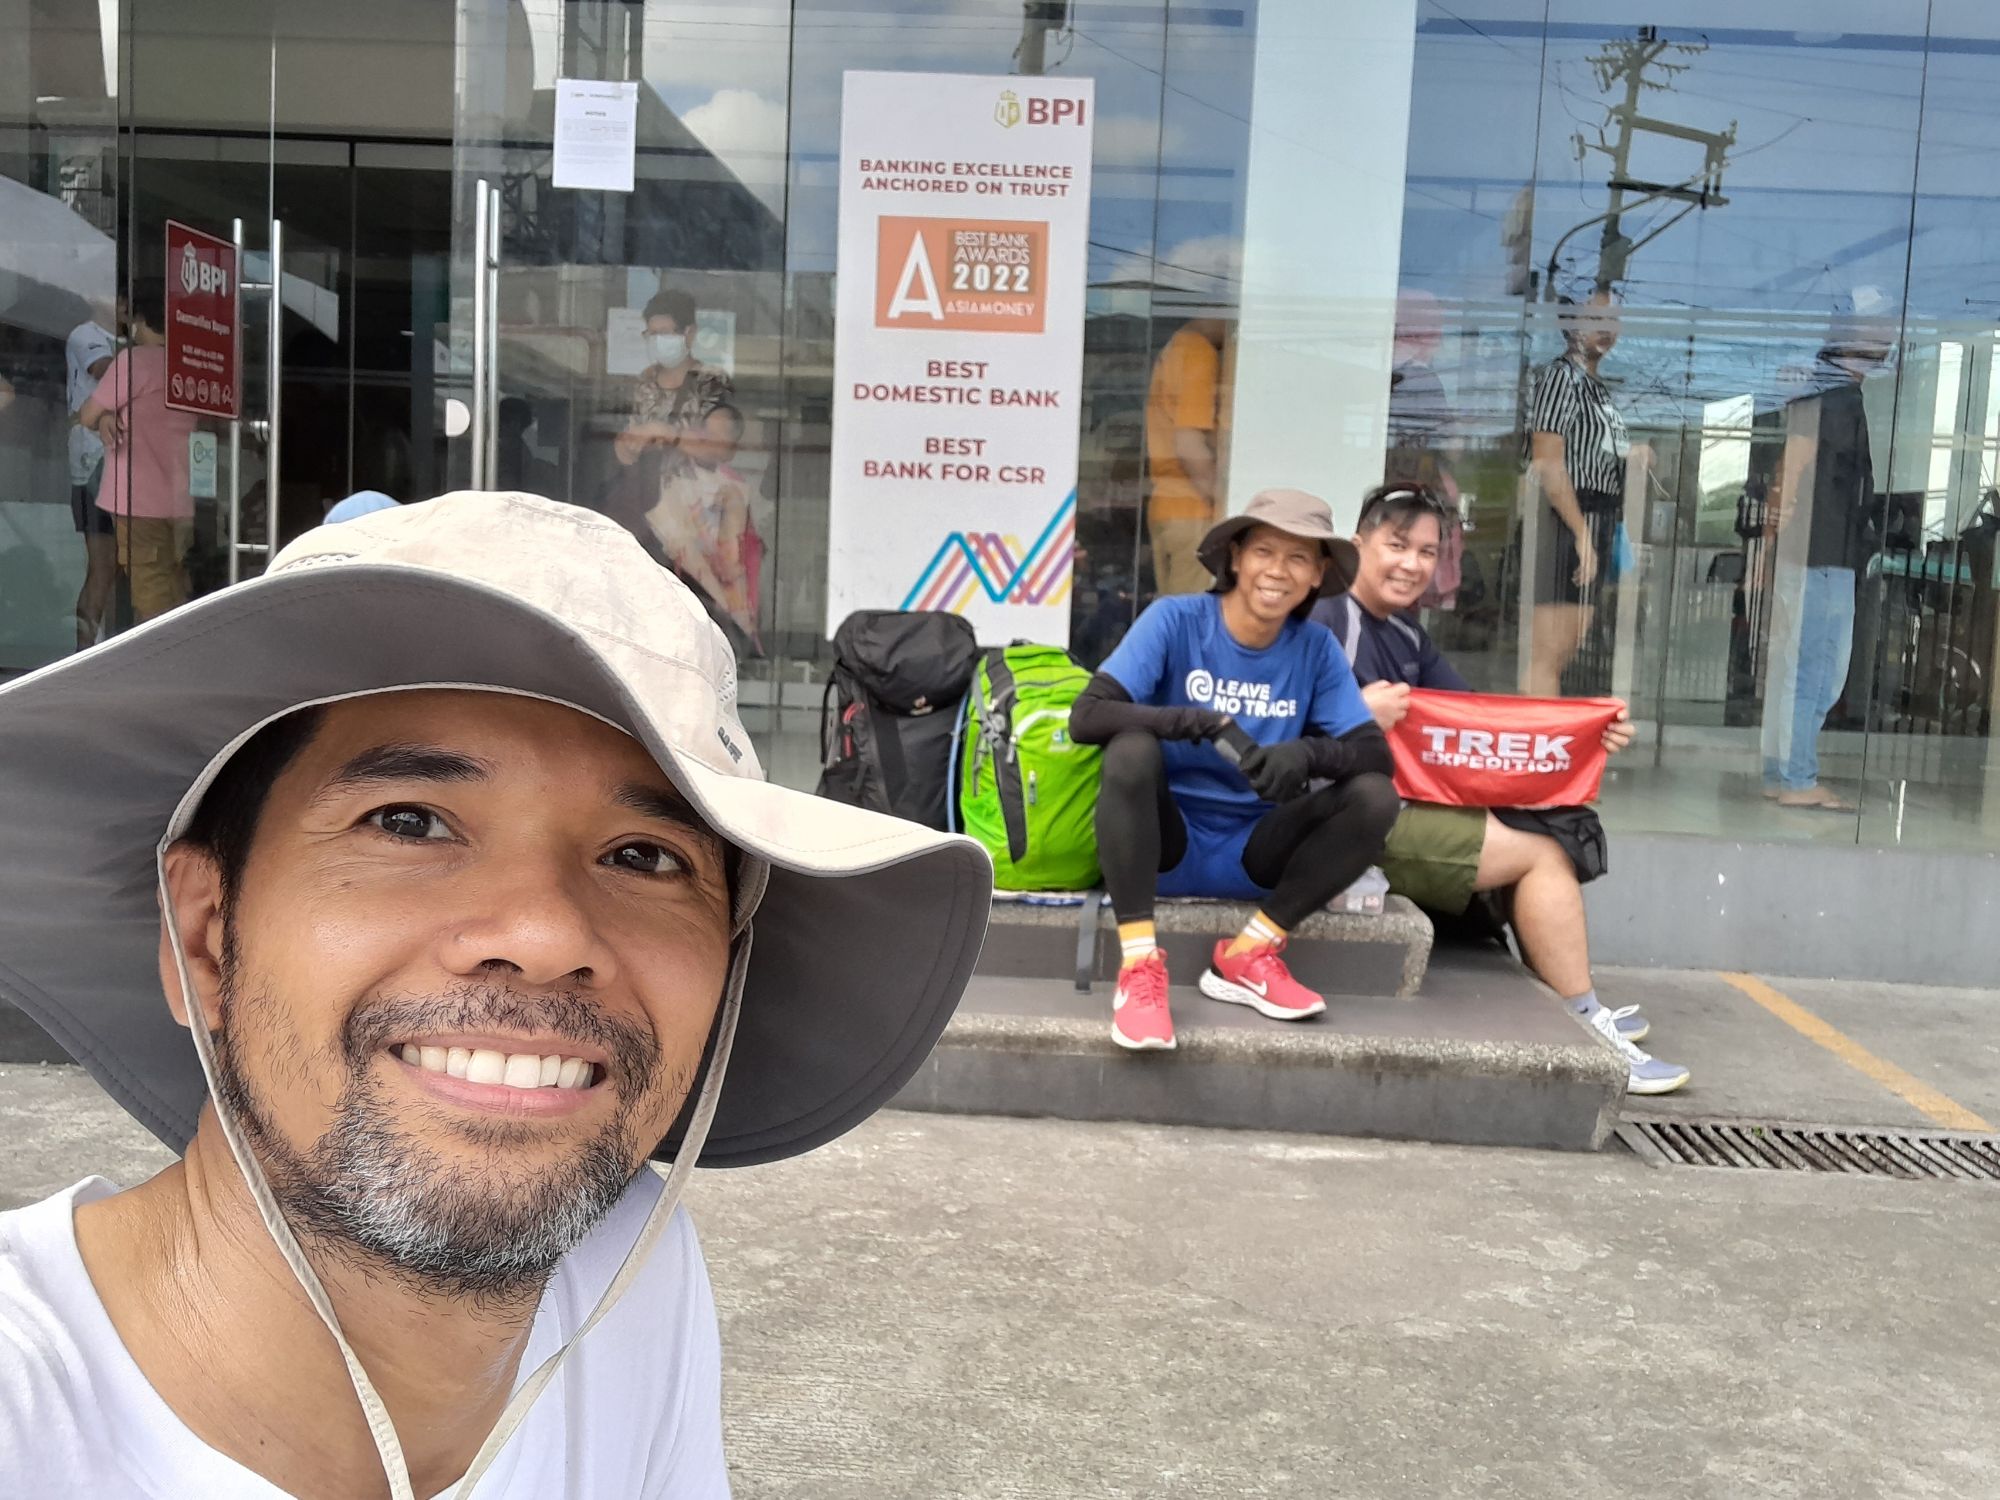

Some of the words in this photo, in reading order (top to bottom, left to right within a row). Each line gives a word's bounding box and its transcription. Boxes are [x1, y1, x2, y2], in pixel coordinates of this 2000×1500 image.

[1027, 98, 1085, 126] BPI
[860, 159, 946, 175] BANKING
[952, 162, 1072, 179] EXCELLENCE
[862, 177, 968, 194] ANCHORED
[976, 181, 1002, 195] ON
[1011, 182, 1070, 197] TRUST
[954, 231, 987, 246] BEST
[988, 232, 1030, 247] BANK
[953, 246, 1030, 265] AWARDS
[200, 261, 227, 297] BPI
[952, 263, 1030, 292] 2022
[945, 300, 1035, 317] ASIAMONEY
[927, 361, 988, 379] BEST
[853, 384, 981, 405] DOMESTIC
[990, 389, 1060, 408] BANK
[925, 437, 986, 456] BEST
[864, 461, 932, 480] BANK
[941, 464, 990, 482] FOR
[999, 466, 1045, 484] CSR
[1216, 678, 1271, 700] LEAVE
[1214, 695, 1241, 714] NO
[1244, 699, 1297, 718] TRACE
[1421, 725, 1576, 761] TREK
[1421, 750, 1572, 773] EXPEDITION
